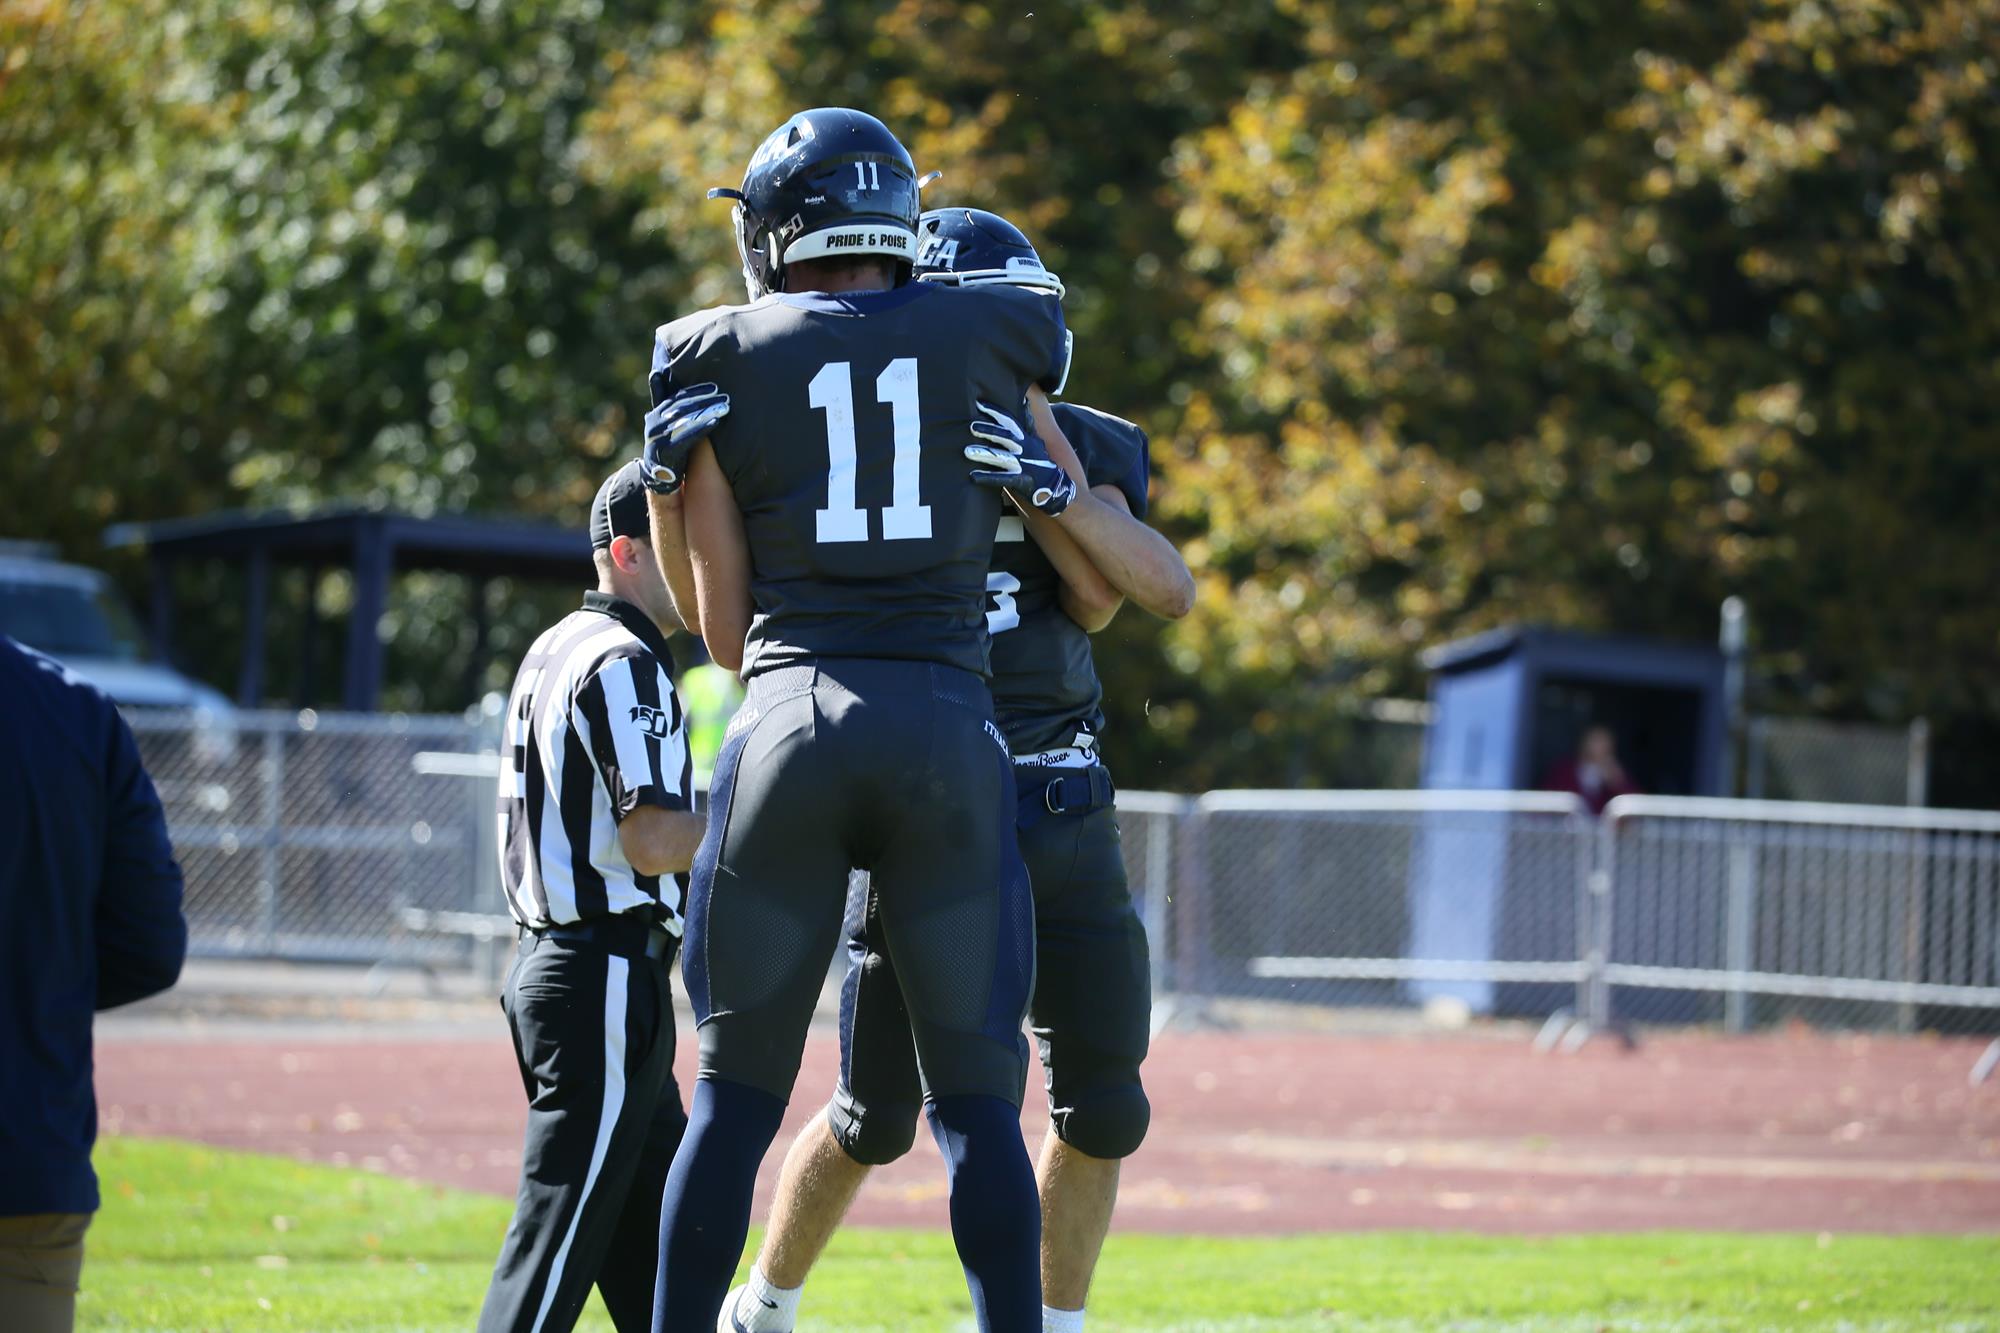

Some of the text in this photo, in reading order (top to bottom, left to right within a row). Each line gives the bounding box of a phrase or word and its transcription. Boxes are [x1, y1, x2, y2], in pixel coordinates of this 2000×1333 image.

[854, 162, 880, 190] 11
[780, 213, 804, 240] 150
[826, 234, 907, 249] PRIDE & POISE
[808, 357, 932, 543] 11
[628, 704, 668, 739] 150
[1082, 721, 1090, 732] L
[984, 720, 1009, 758] ITHACA
